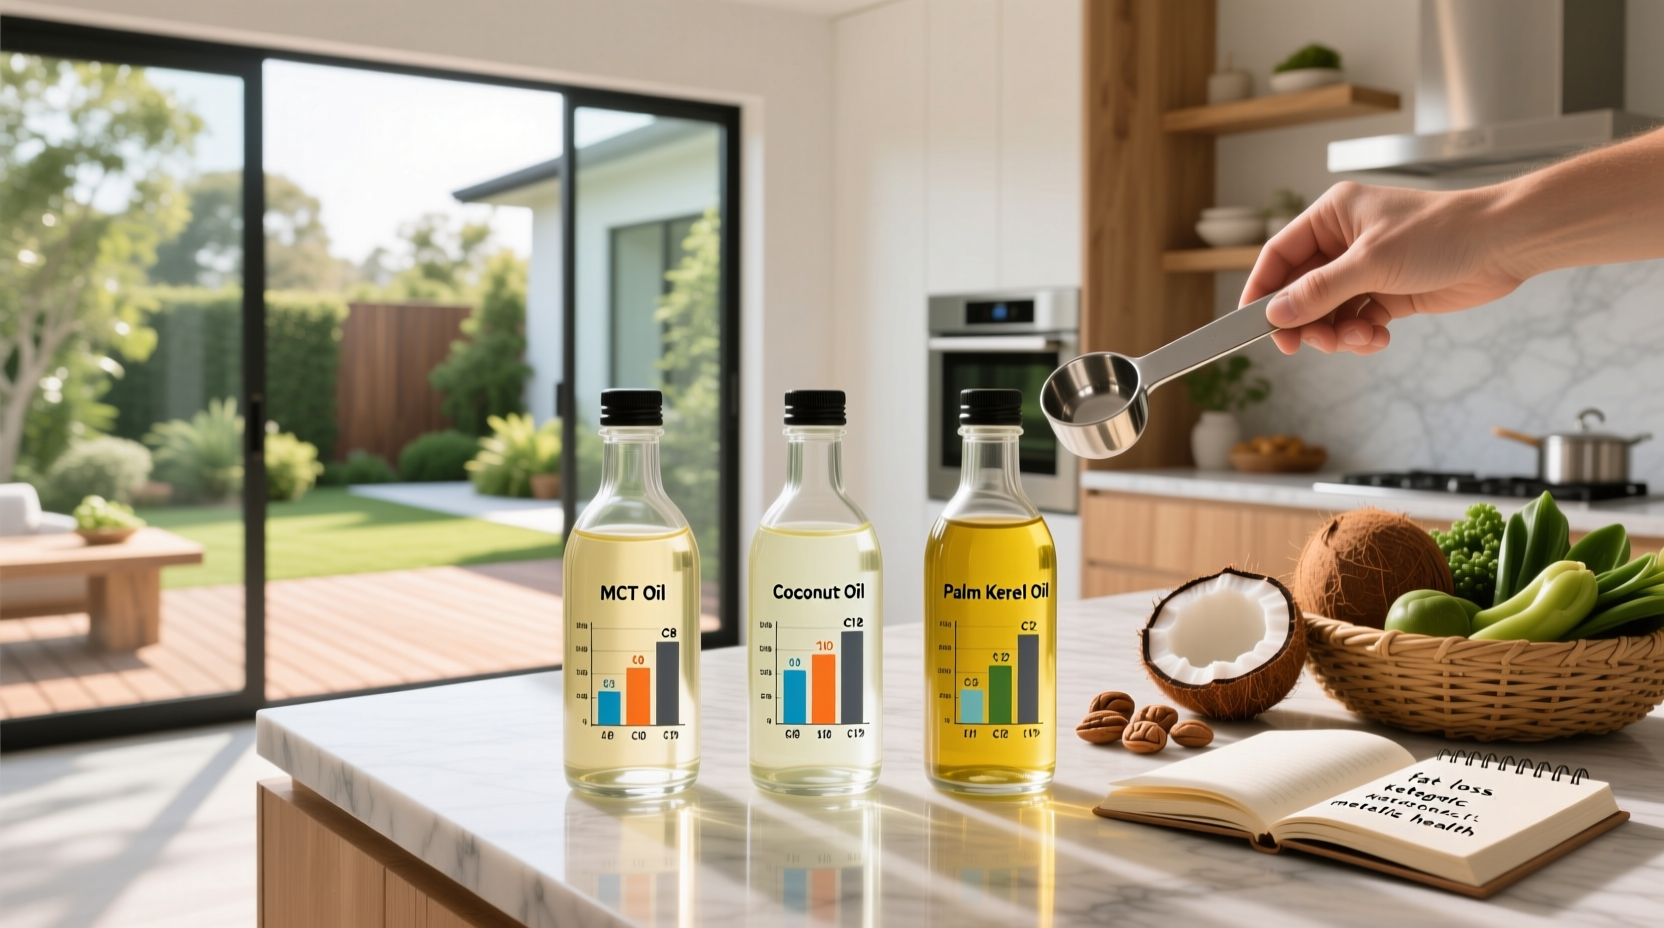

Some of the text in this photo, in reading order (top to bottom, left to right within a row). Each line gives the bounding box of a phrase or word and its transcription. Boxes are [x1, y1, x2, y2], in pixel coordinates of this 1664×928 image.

[600, 584, 666, 601] MCT Oil
[773, 582, 865, 600] Coconut Oil
[943, 582, 1049, 600] Palm Kerel Oil
[1449, 779, 1493, 796] loss
